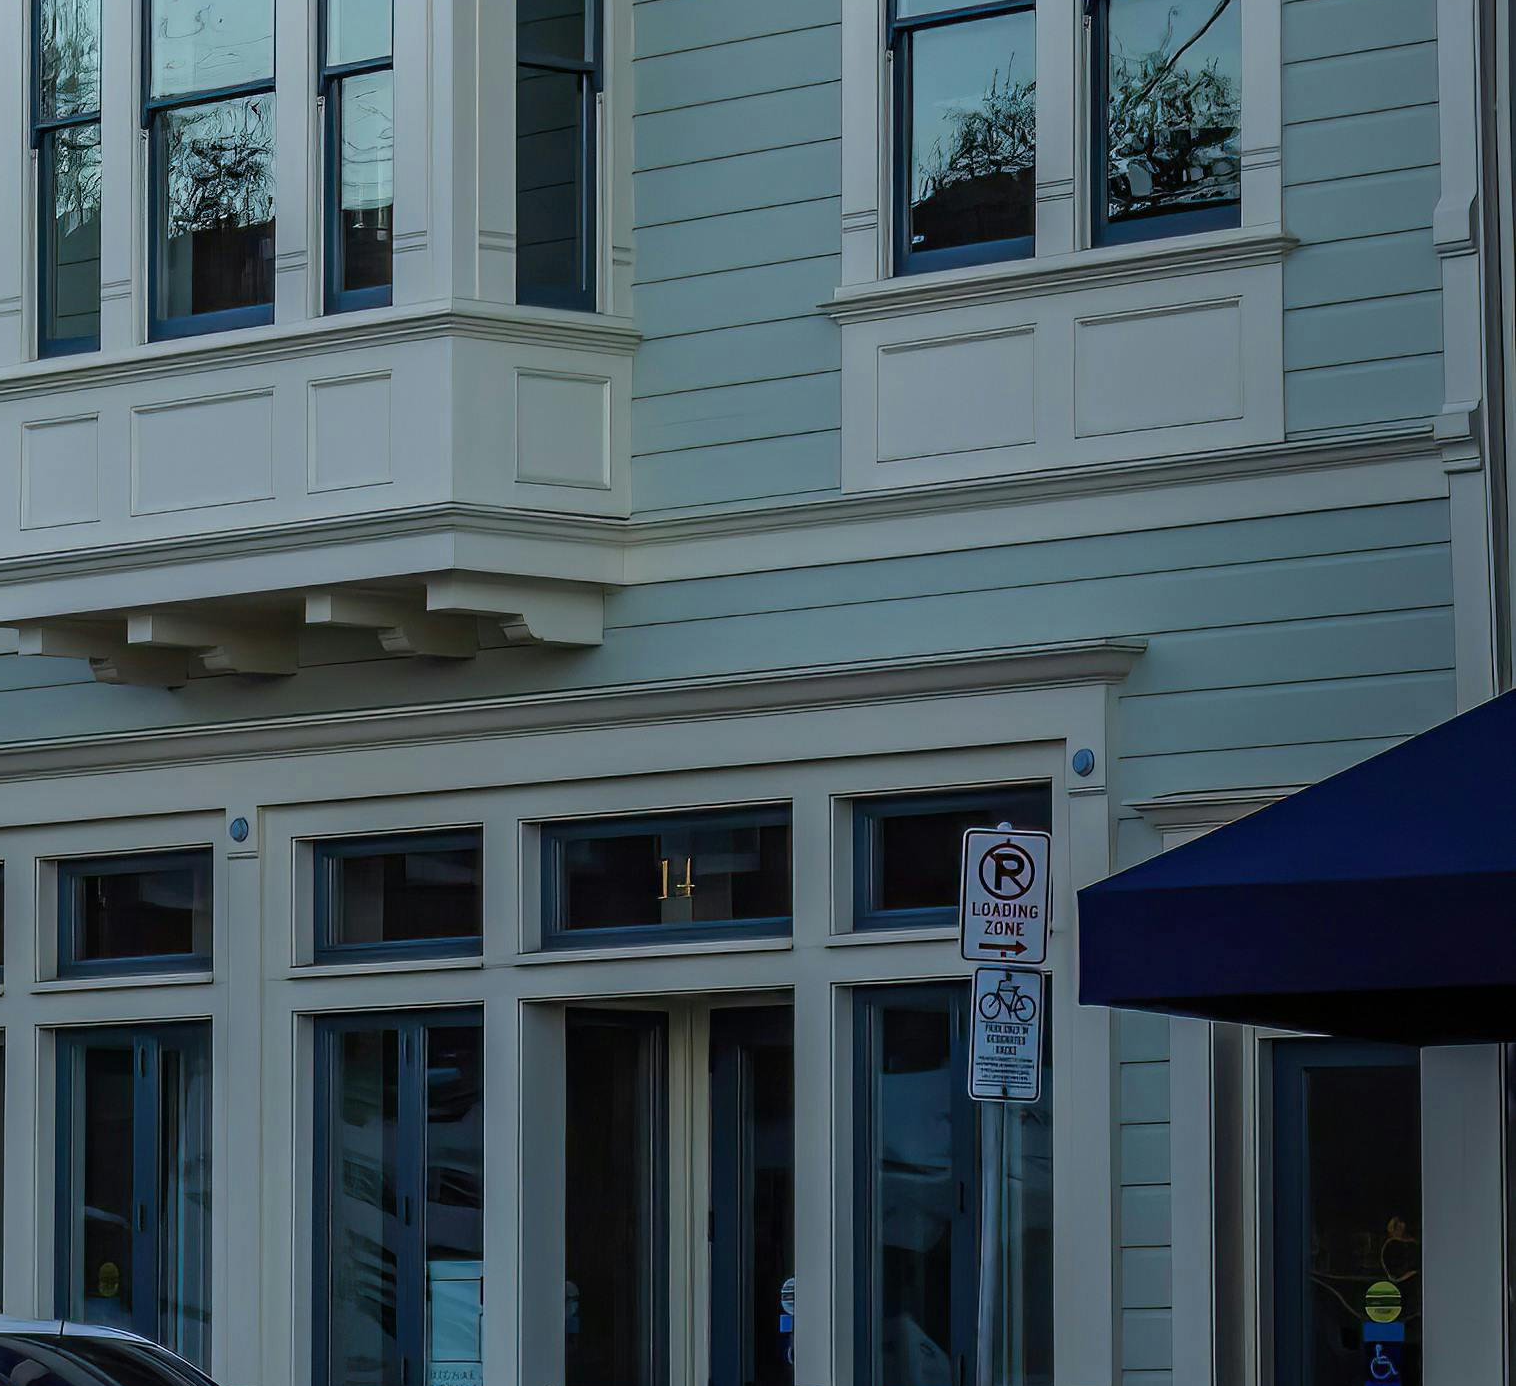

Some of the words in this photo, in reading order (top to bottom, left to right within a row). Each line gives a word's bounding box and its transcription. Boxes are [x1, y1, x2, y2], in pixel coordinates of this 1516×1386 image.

[657, 858, 696, 899] 14
[972, 902, 1039, 918] LOADING
[984, 920, 1025, 936] ZONE
